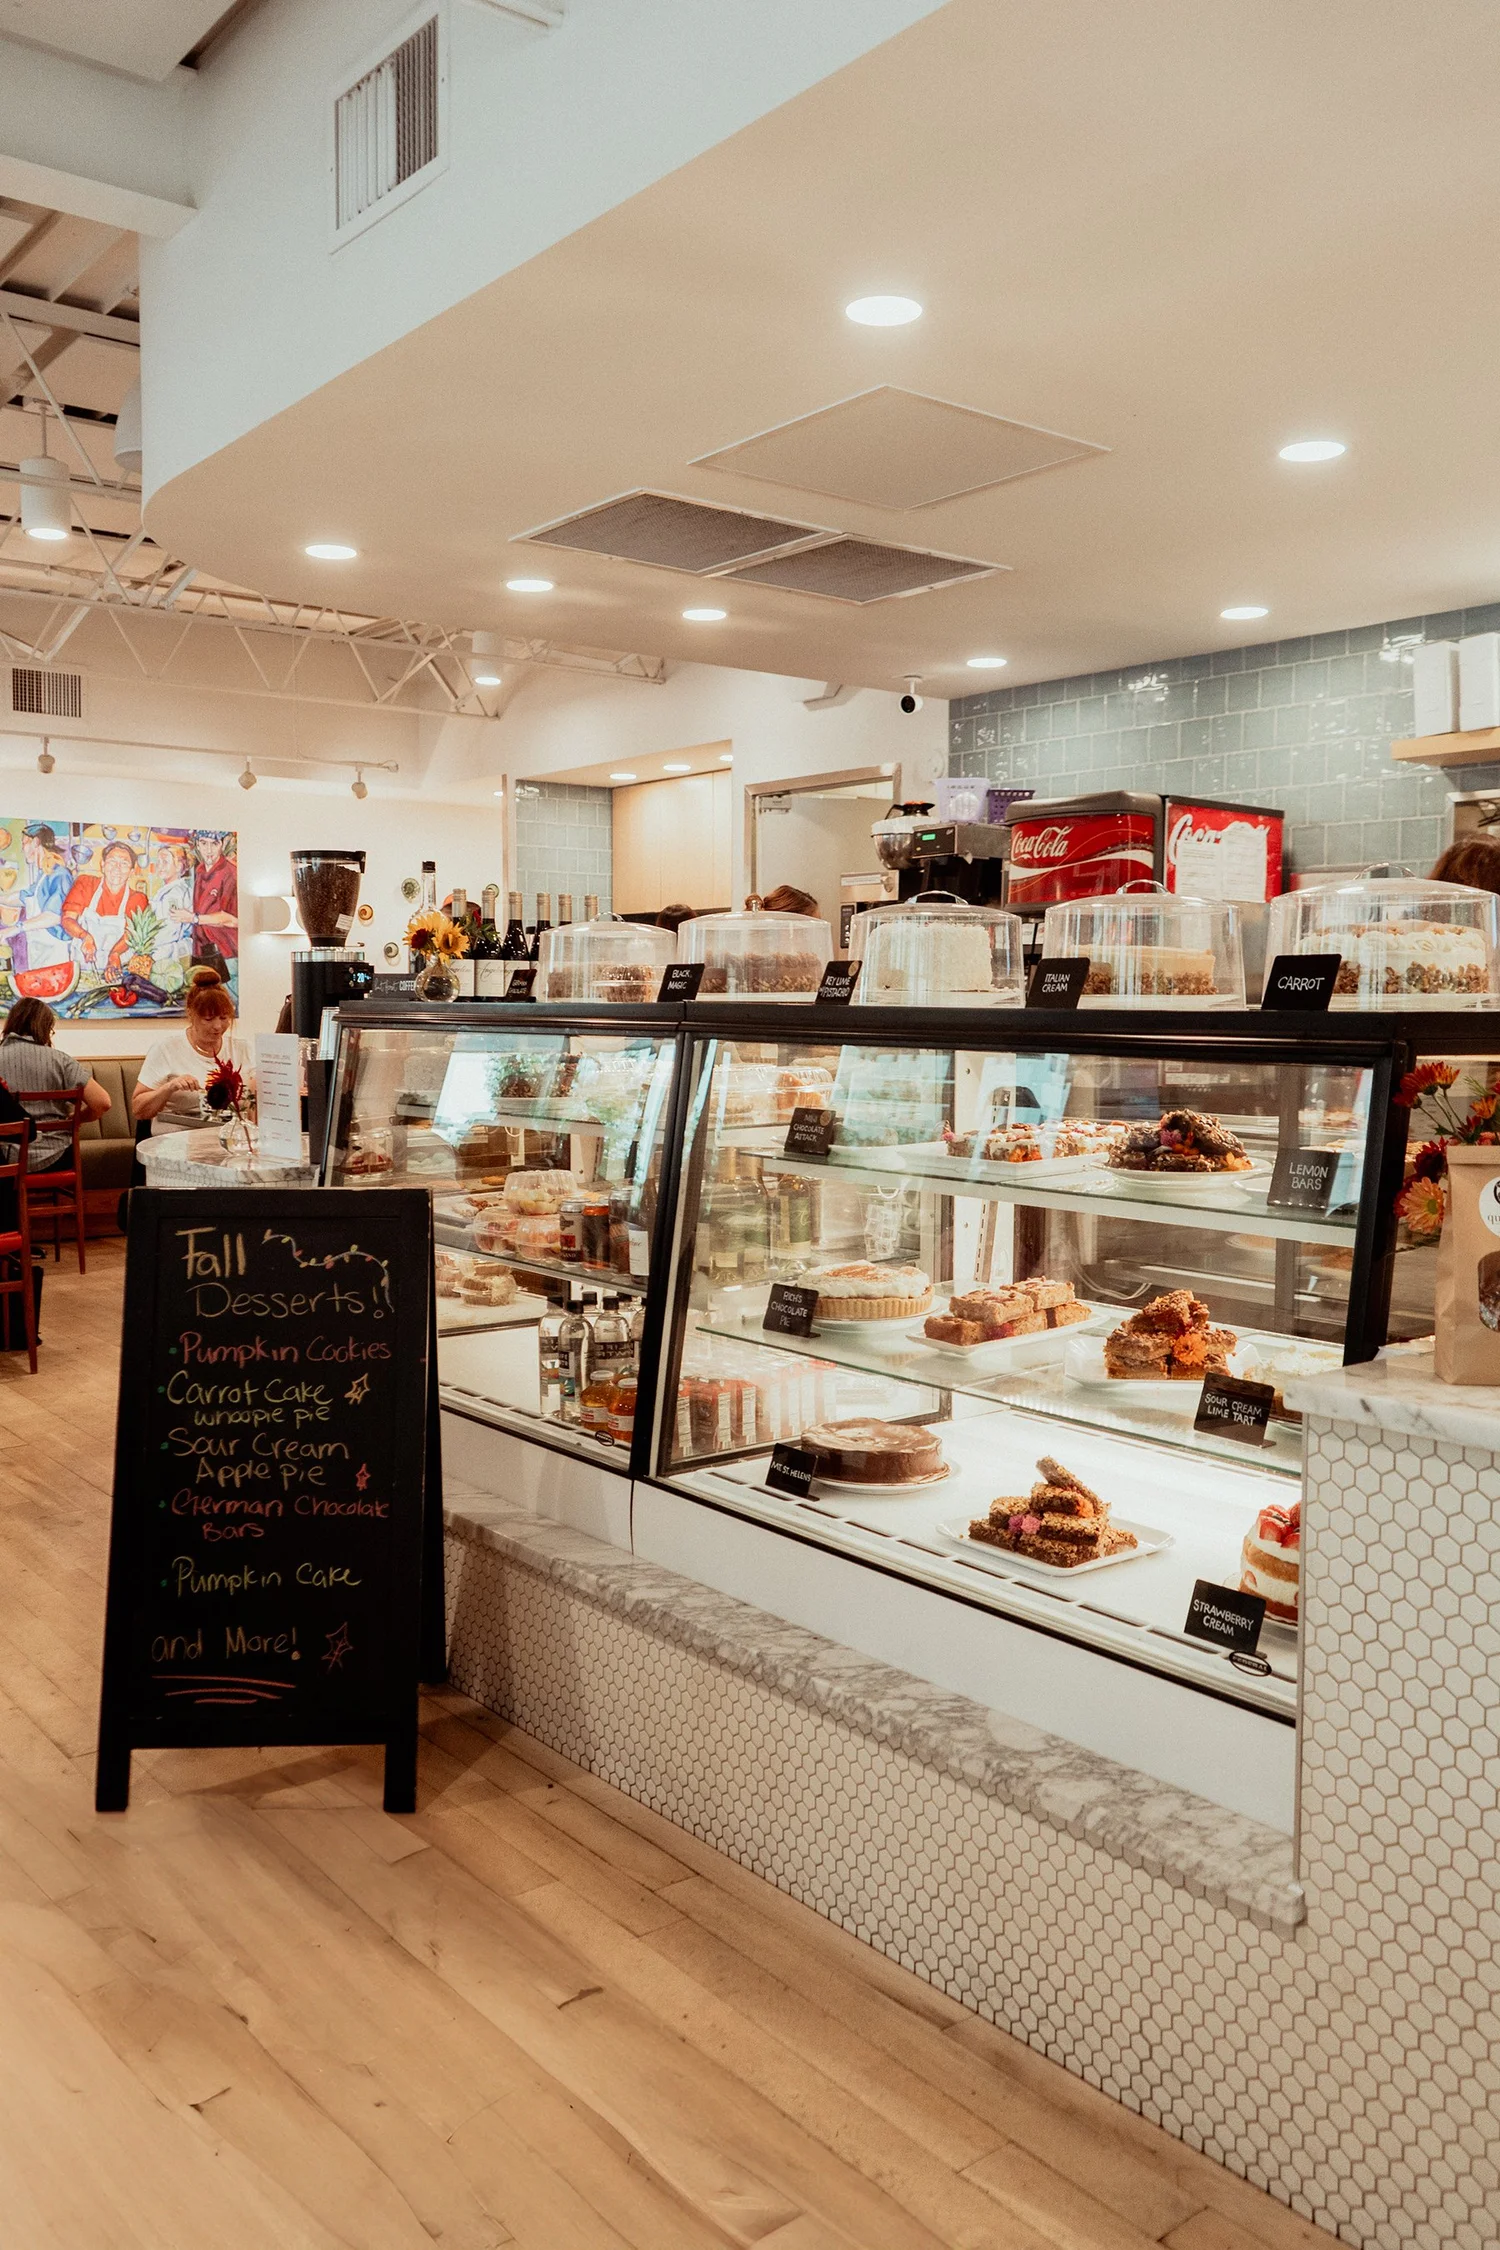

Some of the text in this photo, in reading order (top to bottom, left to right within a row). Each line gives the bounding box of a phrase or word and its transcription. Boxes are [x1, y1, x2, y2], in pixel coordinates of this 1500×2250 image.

[1011, 825, 1074, 861] Coca-Cola
[672, 969, 691, 978] BLACK
[1045, 973, 1070, 983] ITALIAN
[1277, 976, 1325, 992] CARROT
[667, 981, 688, 990] MAGIC
[1042, 982, 1068, 993] CREAM
[793, 1123, 825, 1135] CHOCOLATE
[794, 1132, 817, 1142] ATTACK
[1289, 1162, 1329, 1178] LEMON
[1291, 1176, 1322, 1190] BARS
[175, 1227, 246, 1280] Fall
[187, 1282, 384, 1319] Desserts!
[770, 1300, 808, 1318] CHOCOLATE
[780, 1315, 791, 1327] PIE
[179, 1331, 391, 1368] Pumpkin Cookies
[167, 1370, 333, 1405] Carrot Cake
[1204, 1393, 1262, 1417] SOUR CREAM
[1207, 1404, 1256, 1426] LIME TART
[294, 1406, 330, 1429] pie
[168, 1428, 349, 1460] Sour Cream
[196, 1457, 271, 1488] Apple
[790, 1469, 811, 1482] HELENS
[171, 1488, 283, 1518] German
[202, 1522, 264, 1542] Bars
[171, 1556, 362, 1597] Pumpkin Cake
[1193, 1599, 1254, 1631] STRAWBERRY
[1203, 1615, 1235, 1636] CREAM
[151, 1626, 301, 1662] and More!
